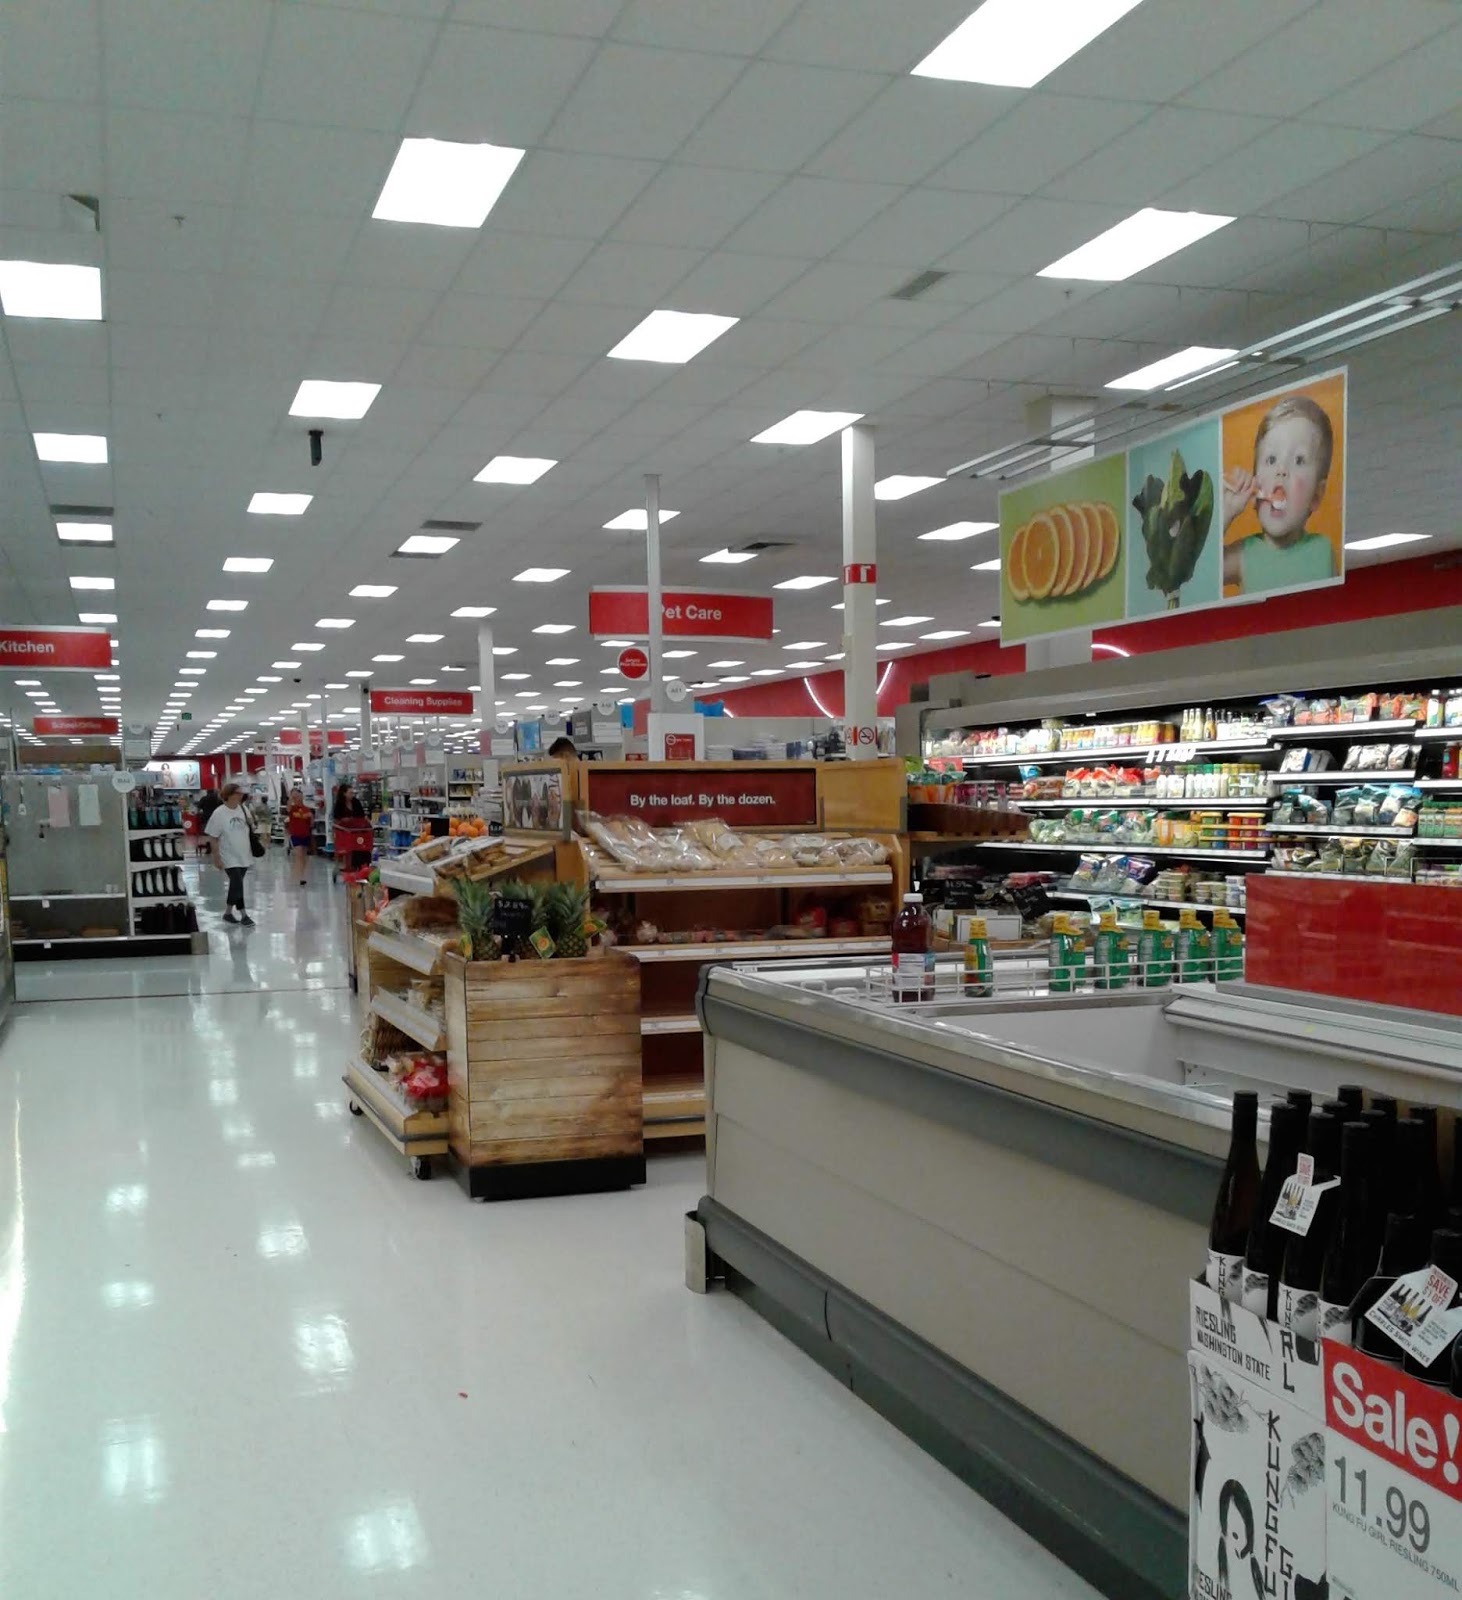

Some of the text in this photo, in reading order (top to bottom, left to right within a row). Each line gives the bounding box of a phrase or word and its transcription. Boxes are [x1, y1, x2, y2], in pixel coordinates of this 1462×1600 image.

[685, 604, 723, 620] Care
[0, 640, 55, 654] Kitchen
[383, 695, 464, 707] Cleaning Supplies
[630, 793, 776, 808] By the loaf. By the dozen.
[1427, 1274, 1451, 1297] SAVE
[1244, 1353, 1272, 1382] STATE
[1332, 1361, 1461, 1485] Sale!
[1334, 1455, 1431, 1554] 11.99
[1332, 1501, 1460, 1593] KUNG FU GIRL RIESLING 750ML
